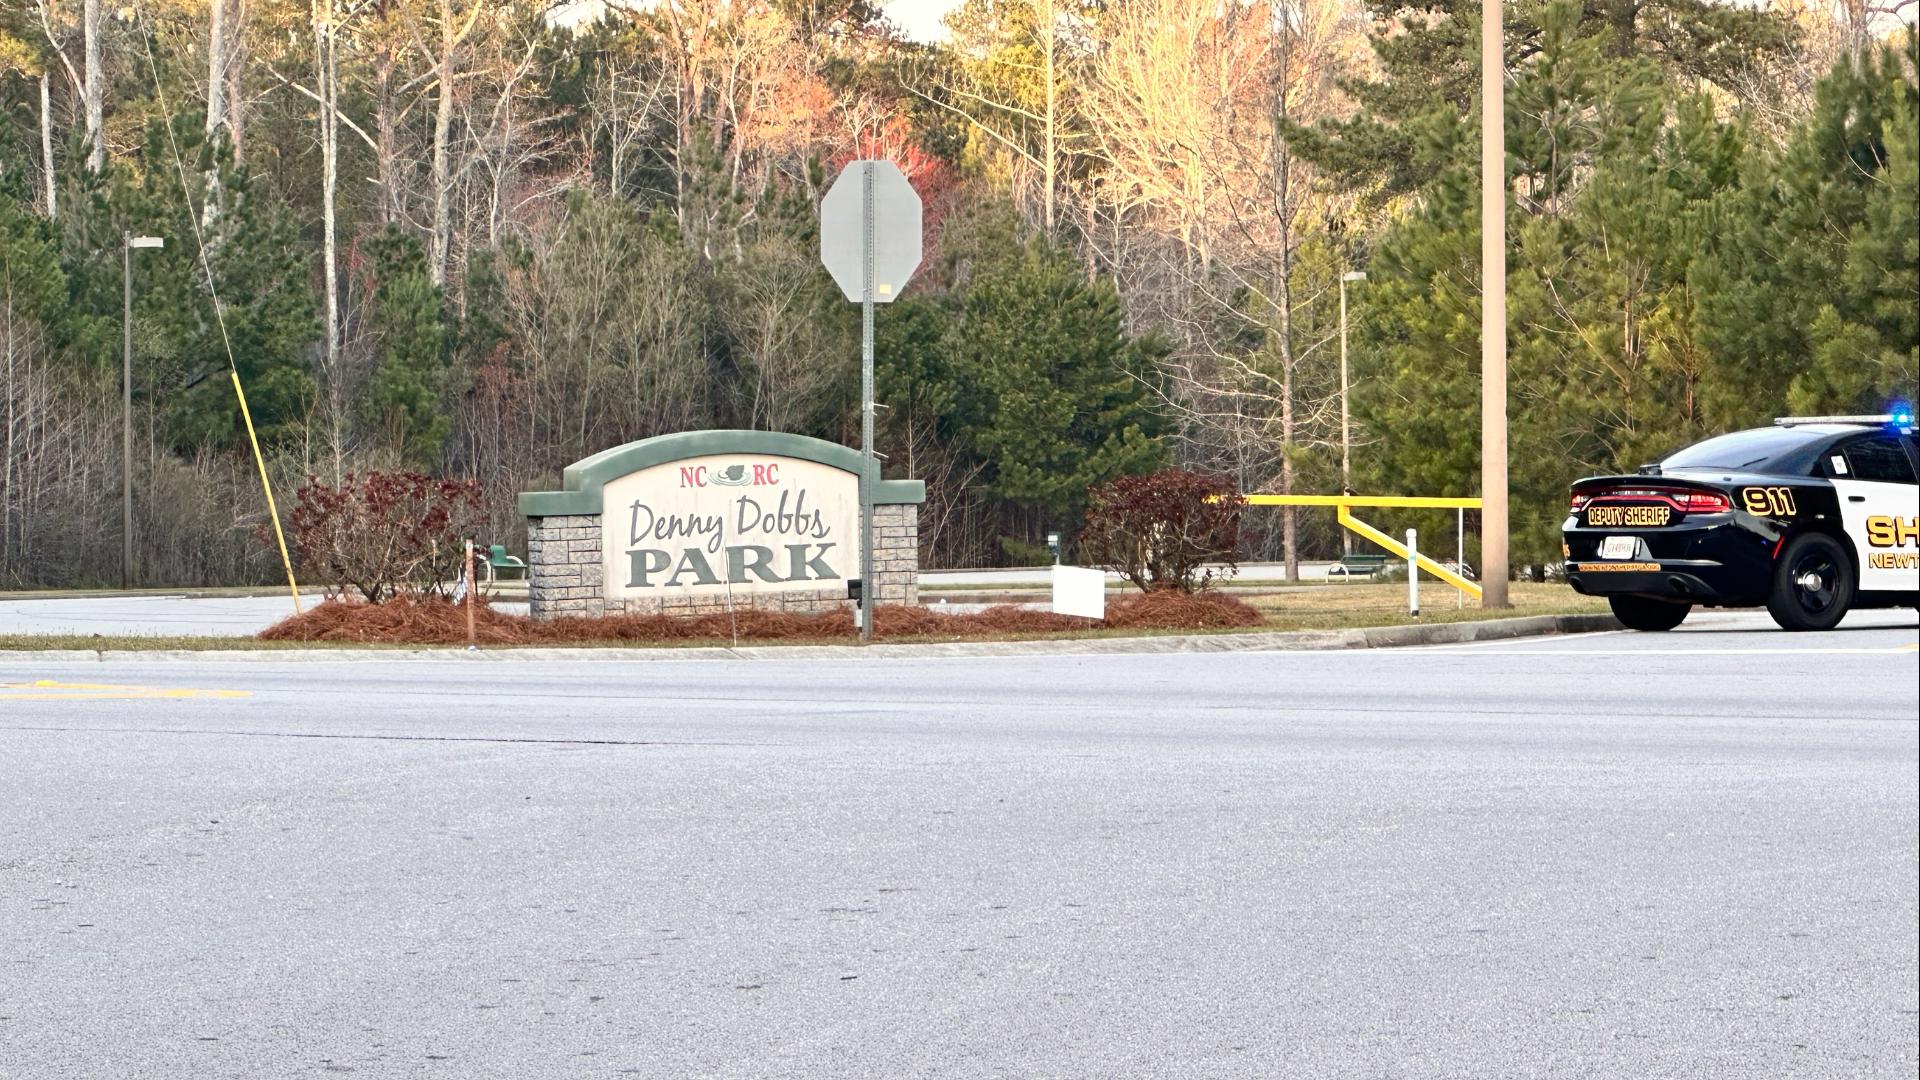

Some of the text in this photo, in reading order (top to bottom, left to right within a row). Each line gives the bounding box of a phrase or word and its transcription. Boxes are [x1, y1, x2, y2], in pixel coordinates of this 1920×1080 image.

[680, 463, 779, 488] NC RC
[1588, 507, 1670, 525] DEPUTY SHERIFF
[1743, 487, 1796, 516] 911
[629, 489, 831, 553] Denny Dobbs
[1866, 516, 1919, 548] SH
[625, 542, 841, 588] PARK
[1868, 553, 1919, 569] NEWT
